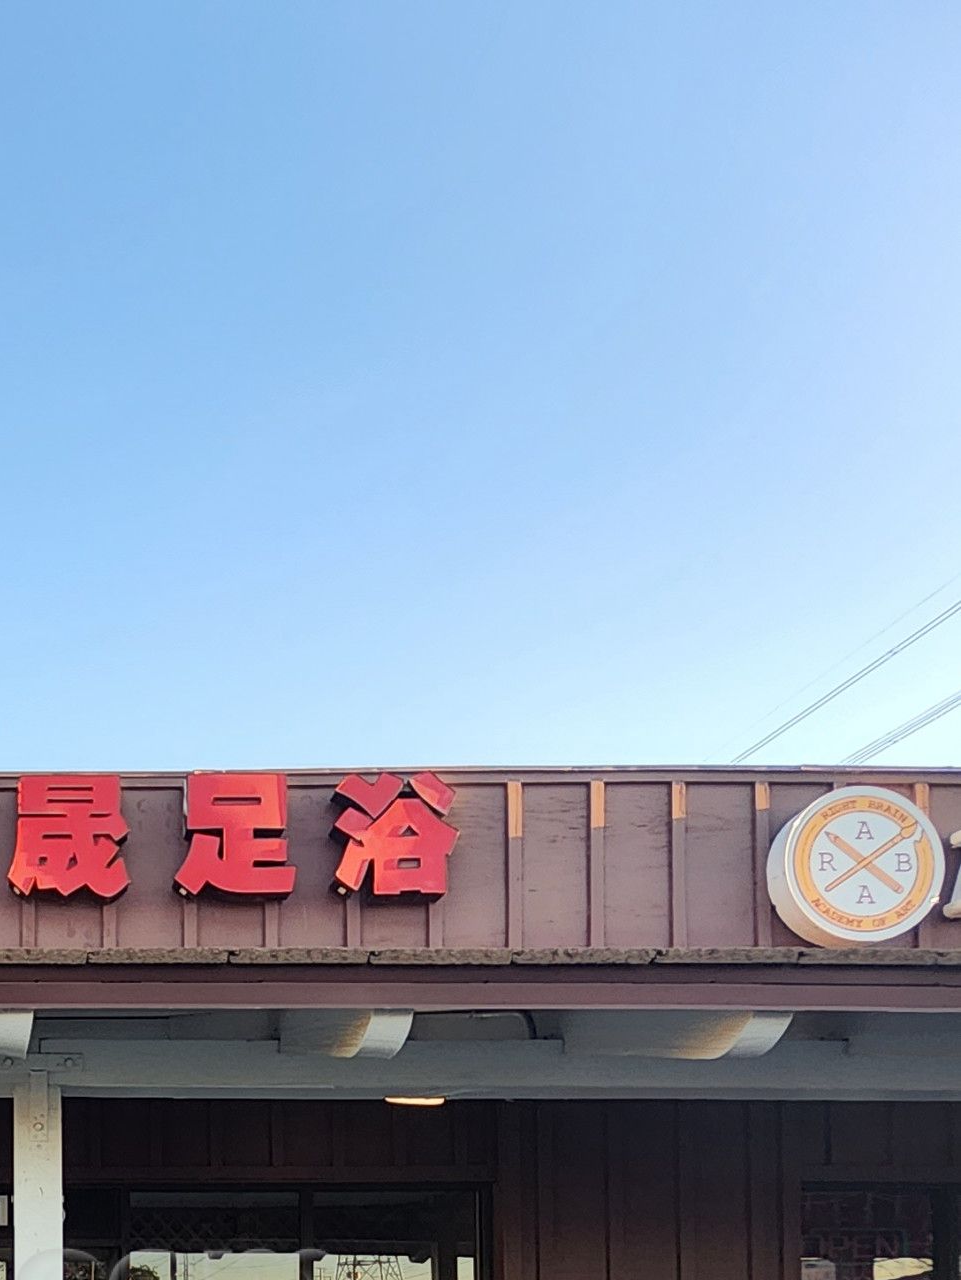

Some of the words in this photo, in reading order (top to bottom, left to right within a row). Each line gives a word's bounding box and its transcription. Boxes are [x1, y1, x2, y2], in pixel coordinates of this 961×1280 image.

[855, 821, 875, 840] A
[818, 852, 837, 872] R
[895, 852, 913, 872] B
[856, 885, 876, 904] A
